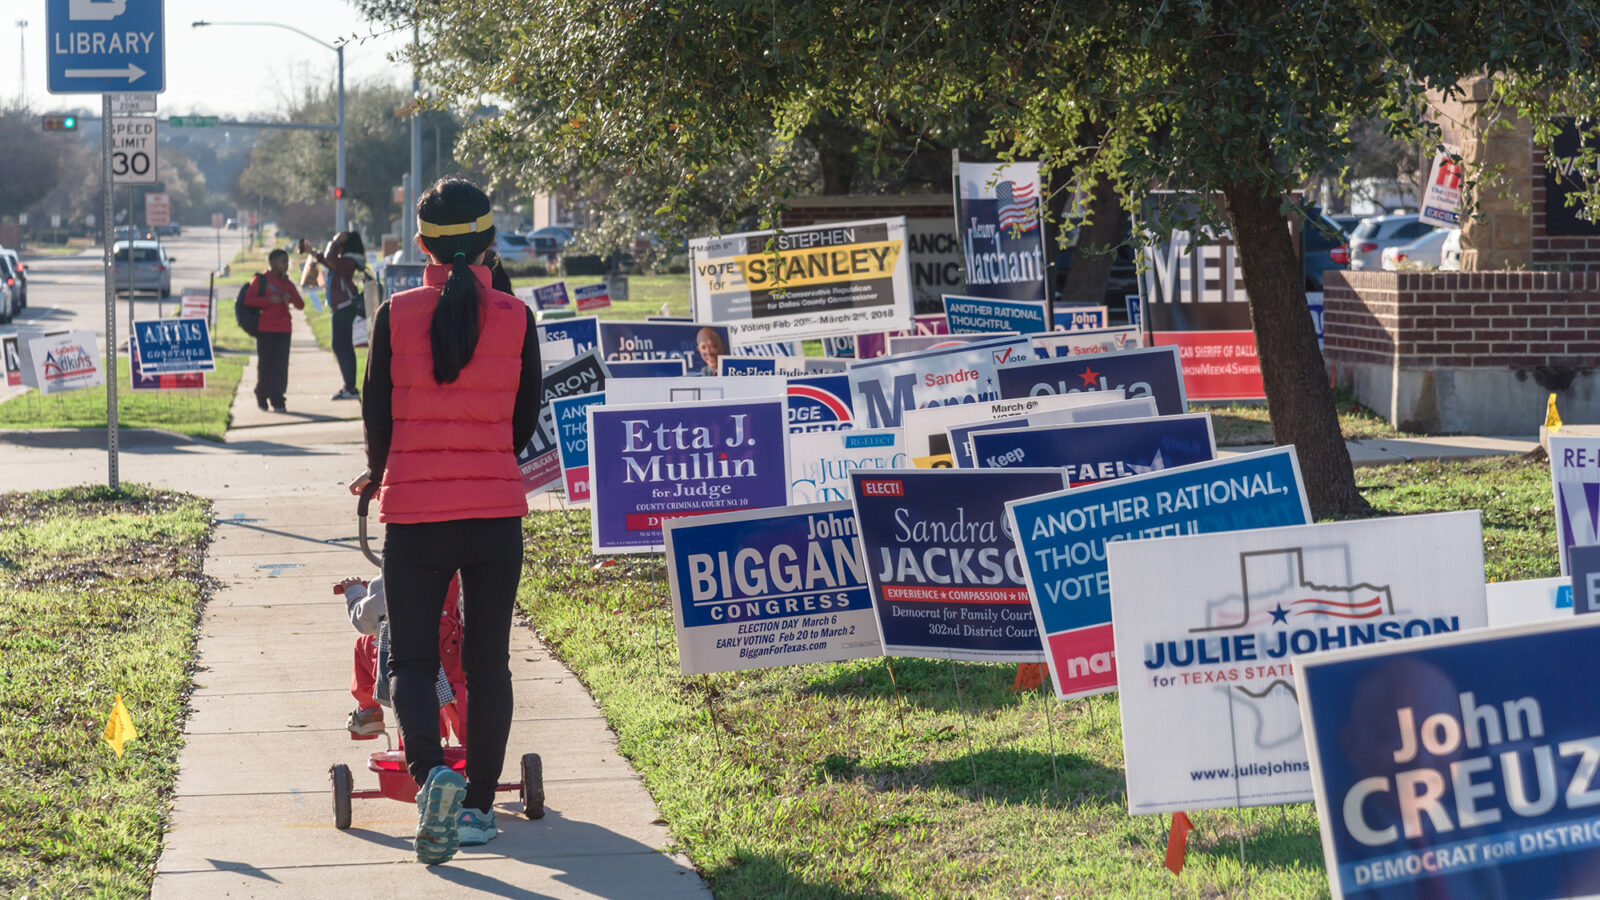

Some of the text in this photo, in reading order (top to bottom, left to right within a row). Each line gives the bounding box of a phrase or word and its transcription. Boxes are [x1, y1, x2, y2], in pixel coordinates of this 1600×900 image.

[55, 32, 155, 54] LIBRARY
[112, 138, 148, 149] LIMIT
[112, 152, 150, 175] 30
[778, 229, 856, 249] STEPHEN
[971, 217, 996, 244] Kenny
[697, 243, 721, 252] March
[962, 228, 1044, 285] Marchant
[698, 262, 735, 276] VOTE
[748, 246, 890, 284] STANLEY
[910, 262, 960, 286] NIC
[708, 279, 726, 291] for
[786, 288, 832, 299] Conservative
[833, 284, 872, 296] Republican
[767, 292, 879, 310] for Dallas County Commissioner
[740, 321, 771, 333] Voting
[773, 320, 791, 329] Feb
[820, 314, 850, 324] March
[871, 309, 894, 319] 2018
[950, 303, 992, 316] ANOTHER
[994, 307, 1042, 321] RATIONAL,
[951, 315, 1012, 330] THOUGHTFUL
[1071, 312, 1097, 324] John
[145, 322, 203, 343] ARTIS
[619, 336, 653, 351] John
[1195, 345, 1222, 358] SHERIFF
[1223, 345, 1234, 357] OF
[44, 350, 92, 376] Adkins
[541, 367, 597, 404] ARON
[925, 369, 980, 387] Sandre
[992, 403, 1024, 413] March
[621, 420, 714, 452] Etta
[726, 414, 756, 448] J.
[622, 451, 757, 483] Mullin
[986, 447, 1025, 468] Keep
[1564, 449, 1600, 468] RE-
[652, 482, 732, 499] for Judge
[866, 483, 900, 494] ELECT!
[636, 501, 666, 511] COUNTY
[667, 500, 700, 510] CRIMINAL
[701, 499, 725, 508] COURT
[726, 499, 738, 507] NO.
[1031, 471, 1289, 541] ANOTHER RATIONAL,
[808, 513, 858, 540] John
[894, 508, 998, 543] Sandra
[688, 537, 868, 601] BIGGAN
[879, 547, 1027, 585] JACKSO
[888, 588, 938, 599] EXPERIENCE
[949, 590, 1007, 600] COMPASSION
[710, 593, 850, 620] CONGRESS
[892, 605, 1033, 622] Democrat for Family Court
[738, 614, 837, 634] ELECTION DAY March 6
[929, 624, 1038, 637] 302nd District Court
[716, 625, 855, 649] EARLY VOTING Feb 20 to March 2
[1145, 616, 1460, 670] JULIE JOHNSON
[739, 640, 827, 659] BigganForTexas.com
[1067, 650, 1118, 679] na
[1153, 674, 1176, 688] for
[1182, 668, 1238, 686] TEXAS
[1393, 691, 1545, 764] John
[1190, 760, 1310, 781] www.juliejohns
[1342, 735, 1600, 847] CREUZ
[1354, 843, 1478, 886] DEMOCRAT
[1483, 840, 1517, 860] FOR
